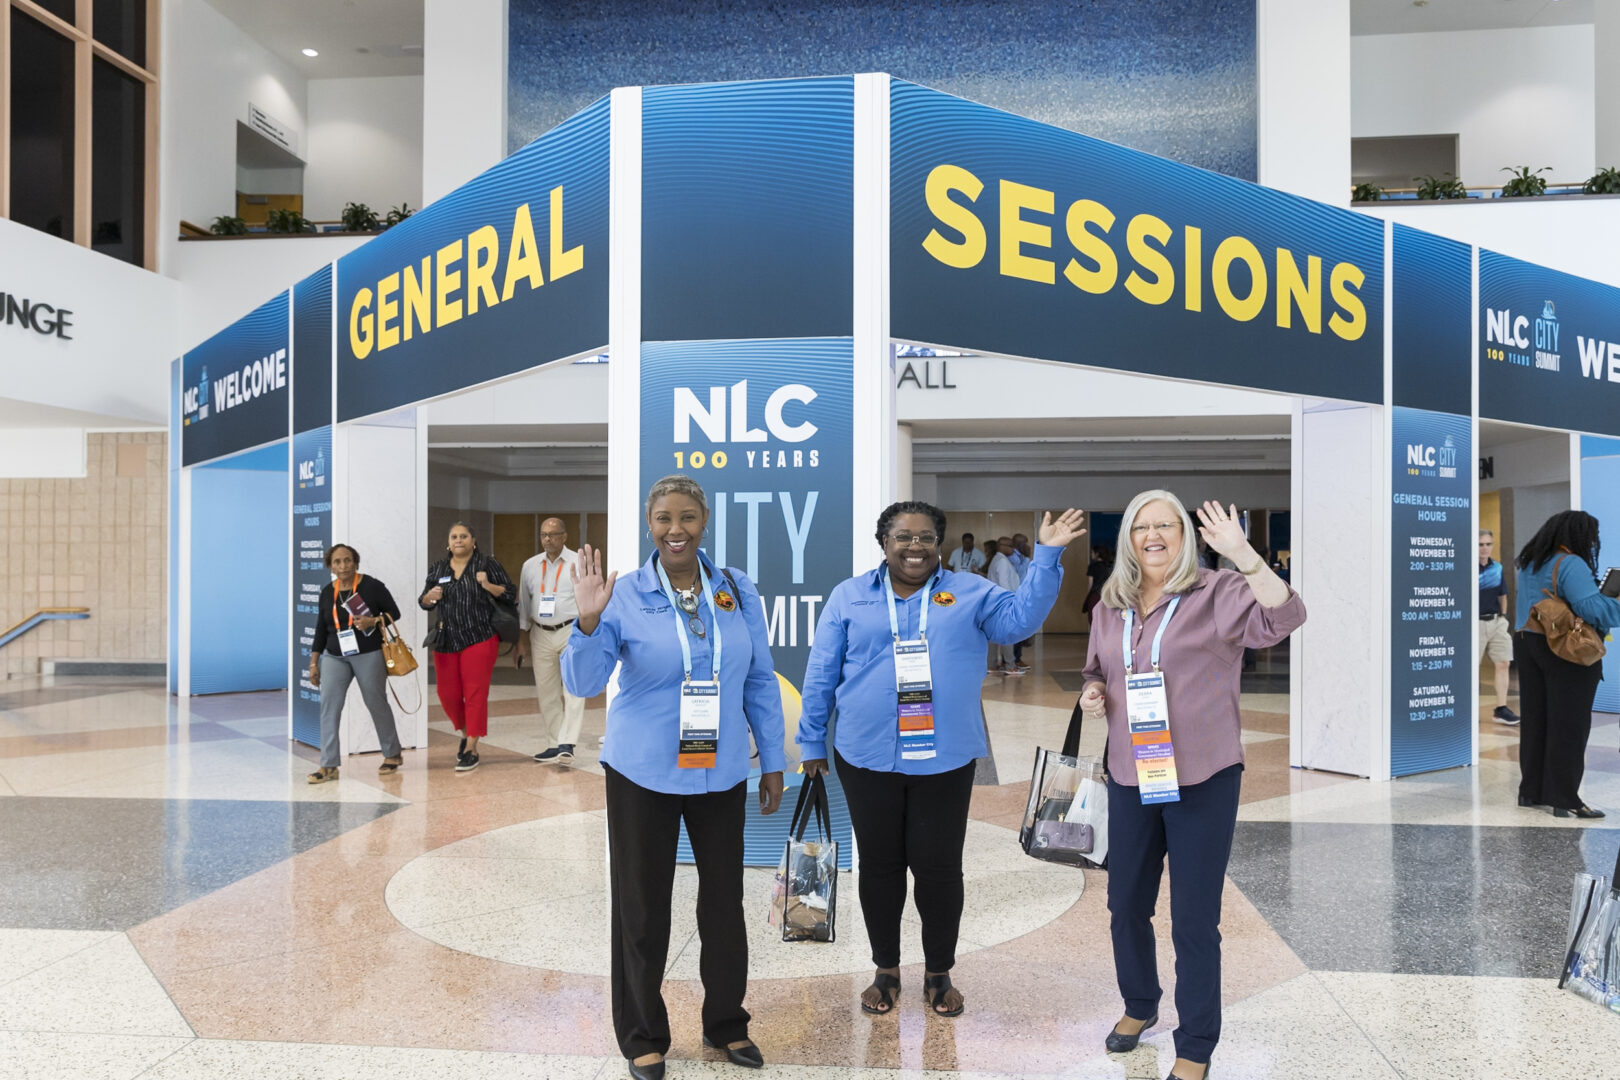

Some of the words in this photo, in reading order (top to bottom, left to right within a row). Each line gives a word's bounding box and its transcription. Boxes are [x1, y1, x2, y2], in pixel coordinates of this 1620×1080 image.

[350, 185, 584, 360] GENERAL
[922, 164, 1367, 341] SESSIONS
[0, 292, 73, 340] NGE
[1487, 307, 1529, 349] NLC
[1535, 318, 1559, 352] CITY
[1487, 348, 1504, 361] 100
[1509, 352, 1529, 366] YEARS
[1535, 350, 1560, 372] SUMMIT
[214, 348, 286, 413] WELCOME
[897, 361, 956, 389] ALL
[674, 379, 818, 443] NLC
[674, 451, 728, 469] 100
[746, 450, 819, 468] YEARS
[1407, 444, 1436, 467] NLC
[1440, 447, 1456, 466] CITY
[1408, 468, 1419, 476] 100
[1393, 493, 1433, 506] GENERAL
[1435, 496, 1469, 508] SESSION
[1418, 510, 1447, 521] HOURS
[699, 491, 819, 584] ITY
[1410, 537, 1454, 547] WEDNESDAY,
[1409, 549, 1446, 557] NOVEMBER
[1448, 549, 1455, 557] 13
[1410, 562, 1425, 571] 2:00
[1430, 562, 1444, 571] 3:30
[1445, 562, 1454, 571] PM
[1413, 587, 1451, 596] THURSDAY,
[1409, 598, 1446, 607] NOVEMBER
[1448, 598, 1455, 606] 14
[1402, 612, 1417, 620] 9:00
[1418, 612, 1429, 620] AM
[1434, 611, 1451, 620] 10:30
[1451, 610, 1462, 619] AM
[1419, 636, 1446, 645] FRIDAY,
[1409, 647, 1446, 657] NOVEMBER
[1448, 647, 1455, 655] 15
[1428, 660, 1442, 670] 2:30
[1443, 660, 1453, 668] PM
[1413, 685, 1451, 695] SATURDAY,
[1409, 696, 1446, 708] NOVEMBER
[1409, 711, 1426, 721] 12:30
[1432, 709, 1444, 719] 2:15
[1445, 708, 1454, 717] PM
